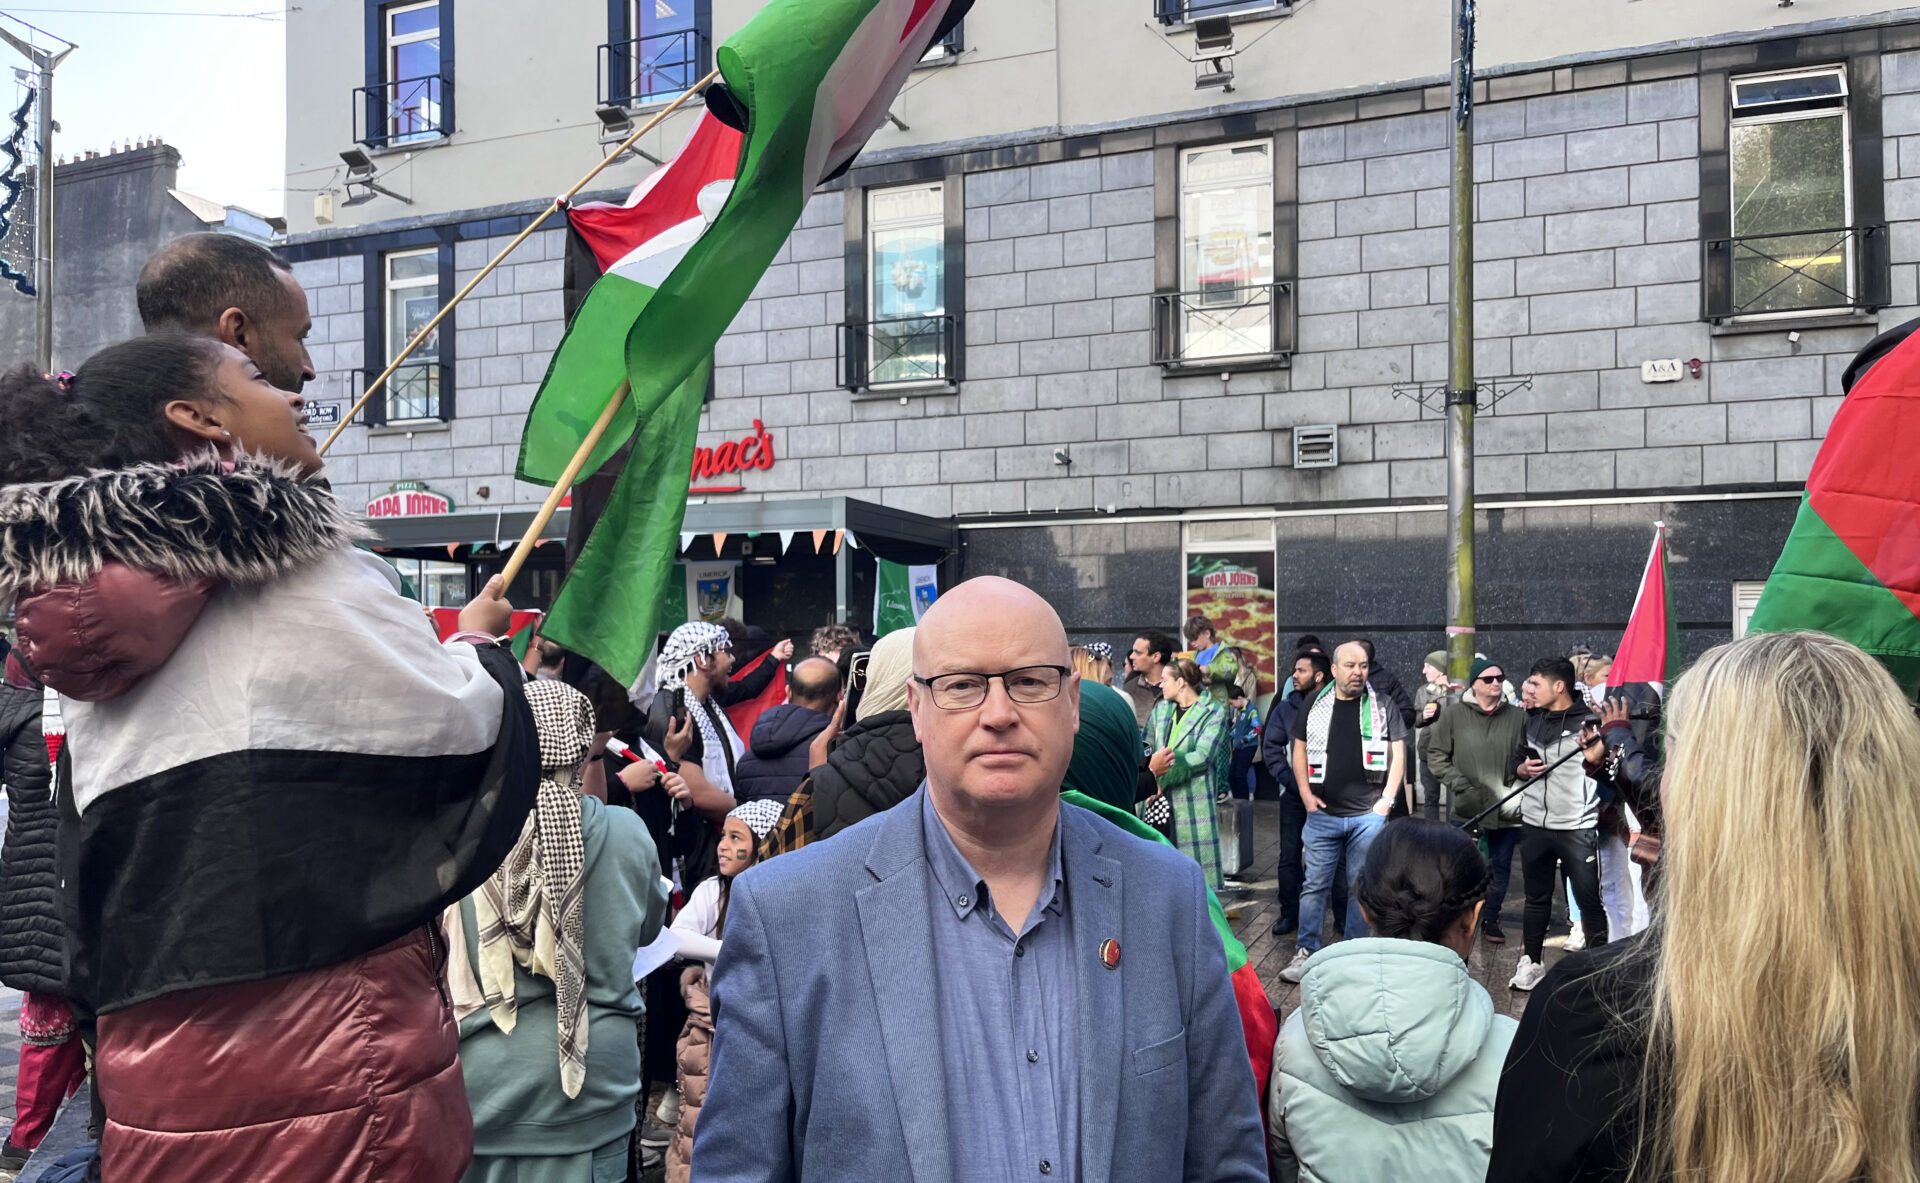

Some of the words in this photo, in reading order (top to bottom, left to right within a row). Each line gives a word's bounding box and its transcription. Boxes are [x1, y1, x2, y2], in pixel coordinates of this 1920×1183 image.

[319, 407, 333, 415] ROW
[396, 481, 417, 490] PIZZA
[368, 495, 401, 517] PAPA
[406, 493, 447, 515] JOHNS
[1205, 572, 1227, 586] PAPA
[1229, 571, 1256, 586] JOHNS
